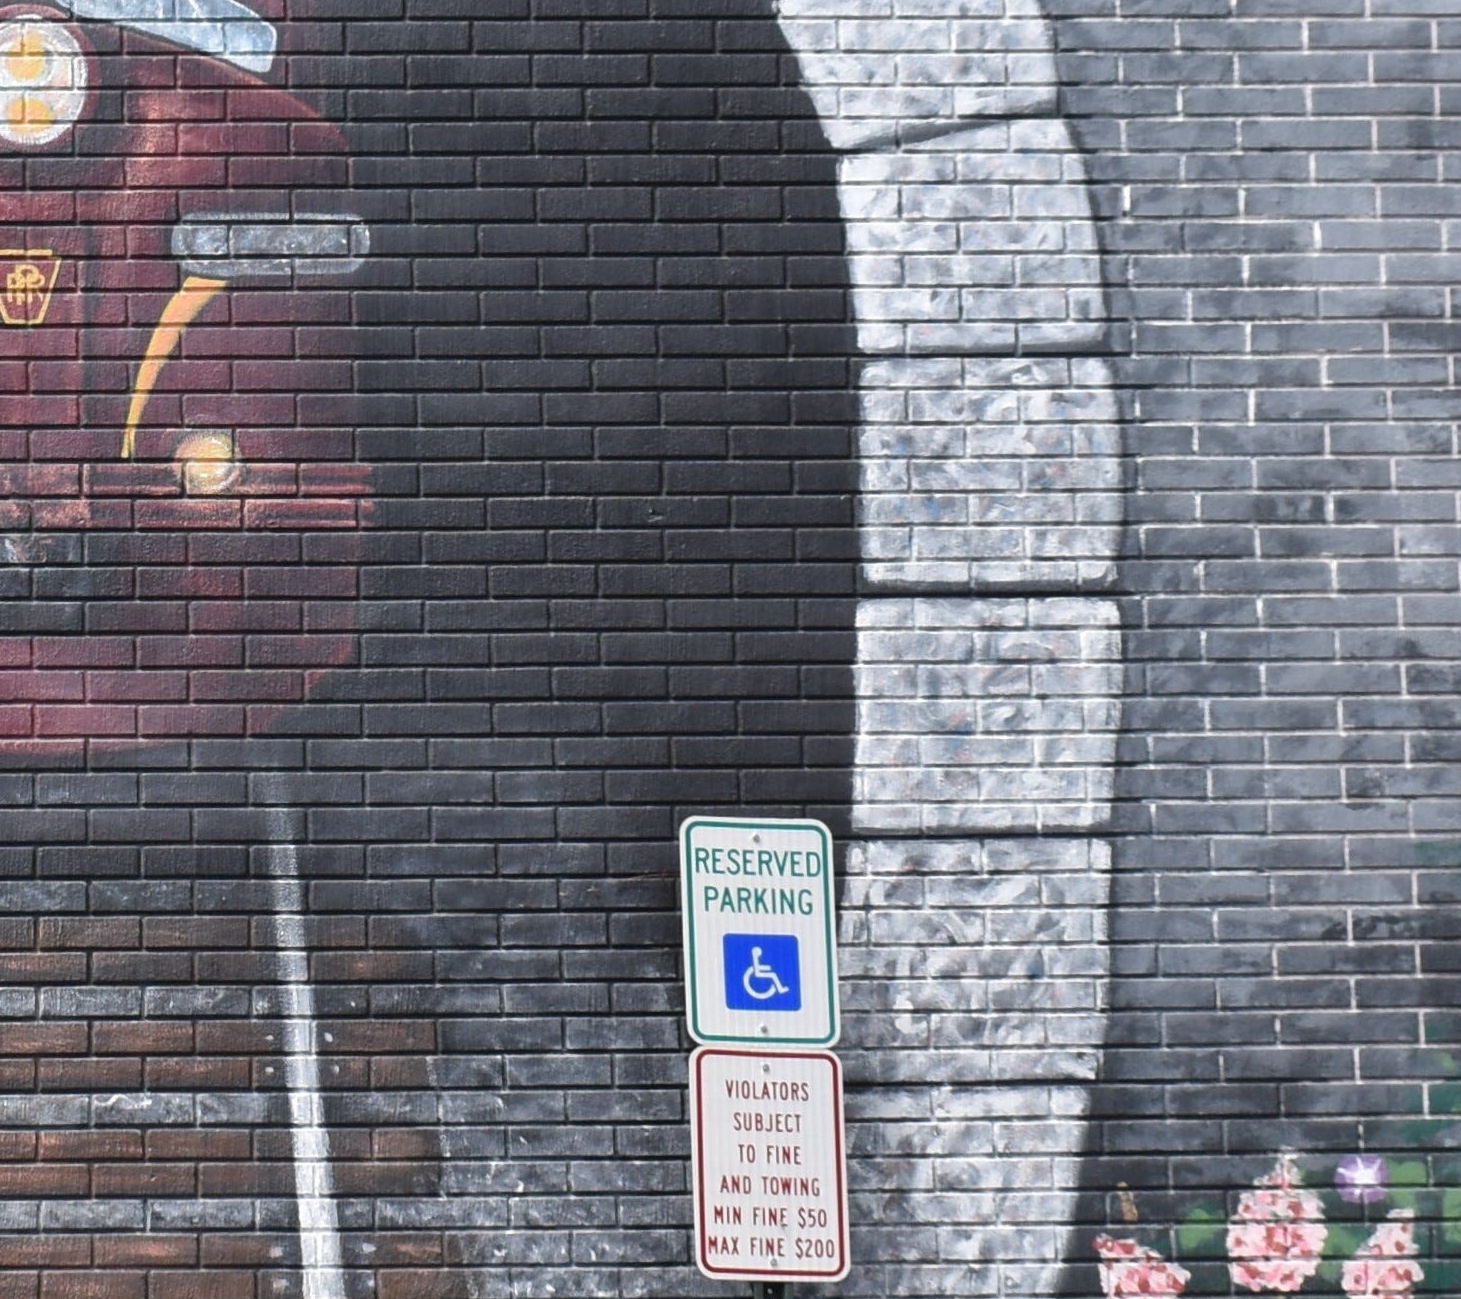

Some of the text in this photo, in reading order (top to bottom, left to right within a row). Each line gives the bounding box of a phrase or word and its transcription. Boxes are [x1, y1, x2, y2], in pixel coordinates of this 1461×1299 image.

[695, 848, 821, 877] RESERVED
[705, 886, 813, 915] PARKING
[726, 1080, 808, 1101] VIOLATORS
[734, 1112, 800, 1132] SUBJECT
[738, 1144, 801, 1165] TO FINE
[721, 1176, 819, 1196] AND TOWING
[714, 1206, 827, 1229] MIN FINE $50
[709, 1236, 834, 1259] MAX FINE $200
